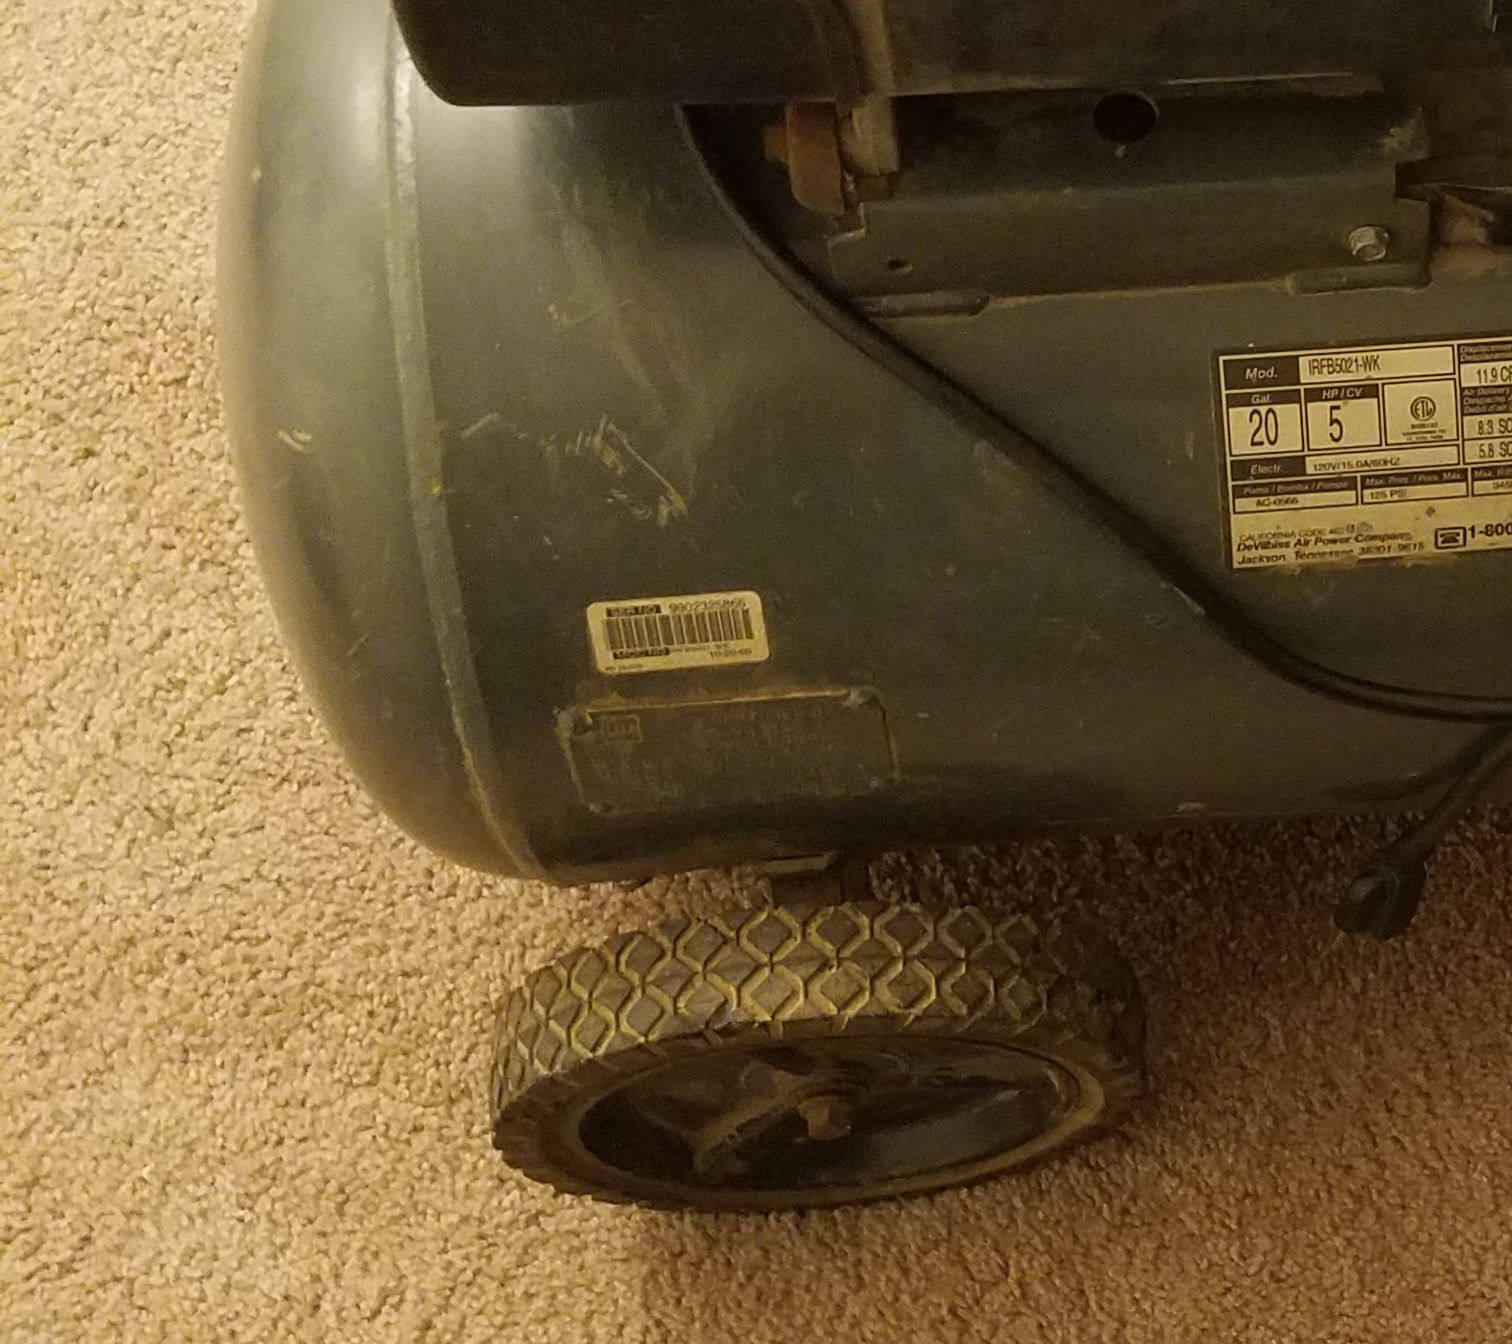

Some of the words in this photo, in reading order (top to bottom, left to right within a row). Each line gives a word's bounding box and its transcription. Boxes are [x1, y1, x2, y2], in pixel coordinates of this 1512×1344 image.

[1245, 365, 1277, 380] Mod.
[1307, 354, 1380, 375] IRFB5021-WK
[1250, 393, 1272, 404] Gal.
[1248, 407, 1278, 447] 20
[1328, 404, 1344, 443] 5
[1293, 537, 1311, 547] Air
[1314, 535, 1351, 545] Power
